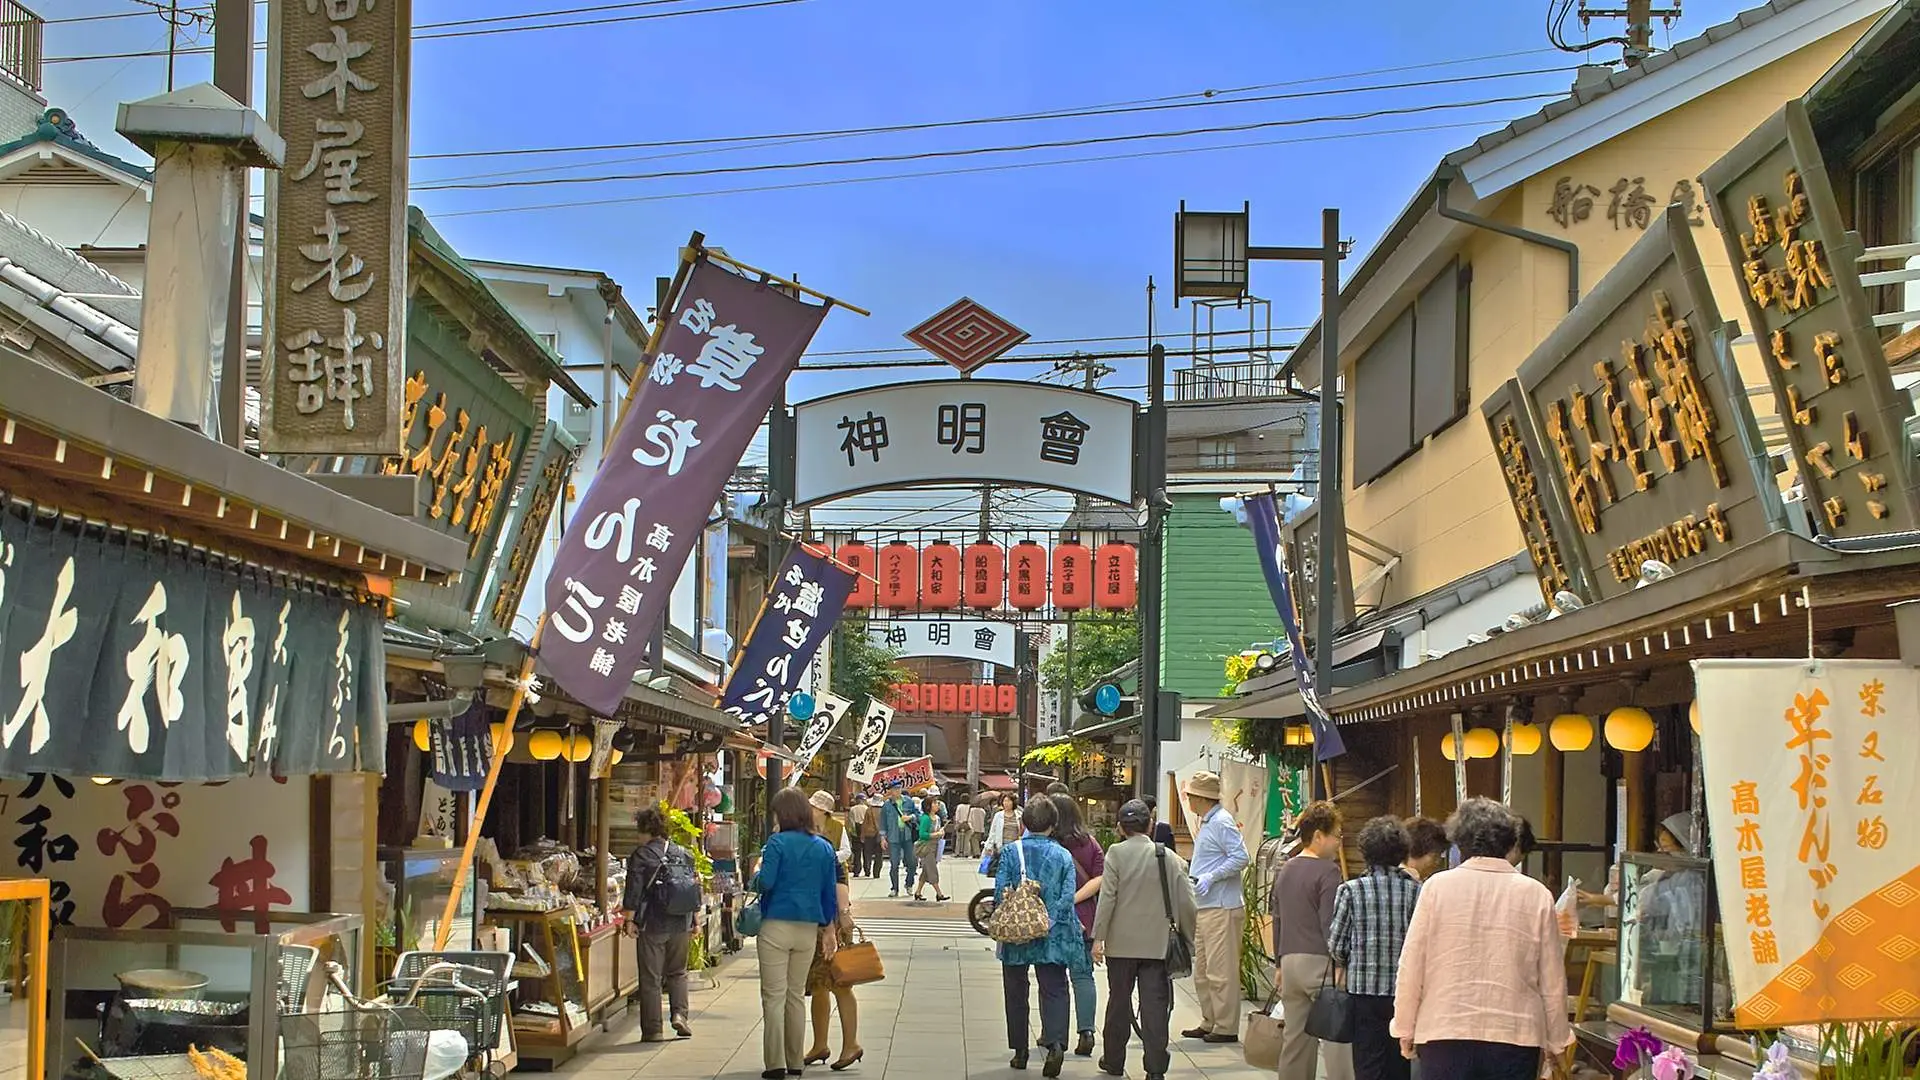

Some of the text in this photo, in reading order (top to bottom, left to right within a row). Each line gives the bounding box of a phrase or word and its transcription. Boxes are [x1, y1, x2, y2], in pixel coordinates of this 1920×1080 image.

[837, 403, 1090, 466] 神明會
[931, 556, 943, 594] 大和家
[1062, 555, 1074, 595] 金子屋
[1108, 555, 1120, 595] 立花屋
[884, 623, 996, 651] 神明會
[1784, 688, 1838, 921] 草だんご
